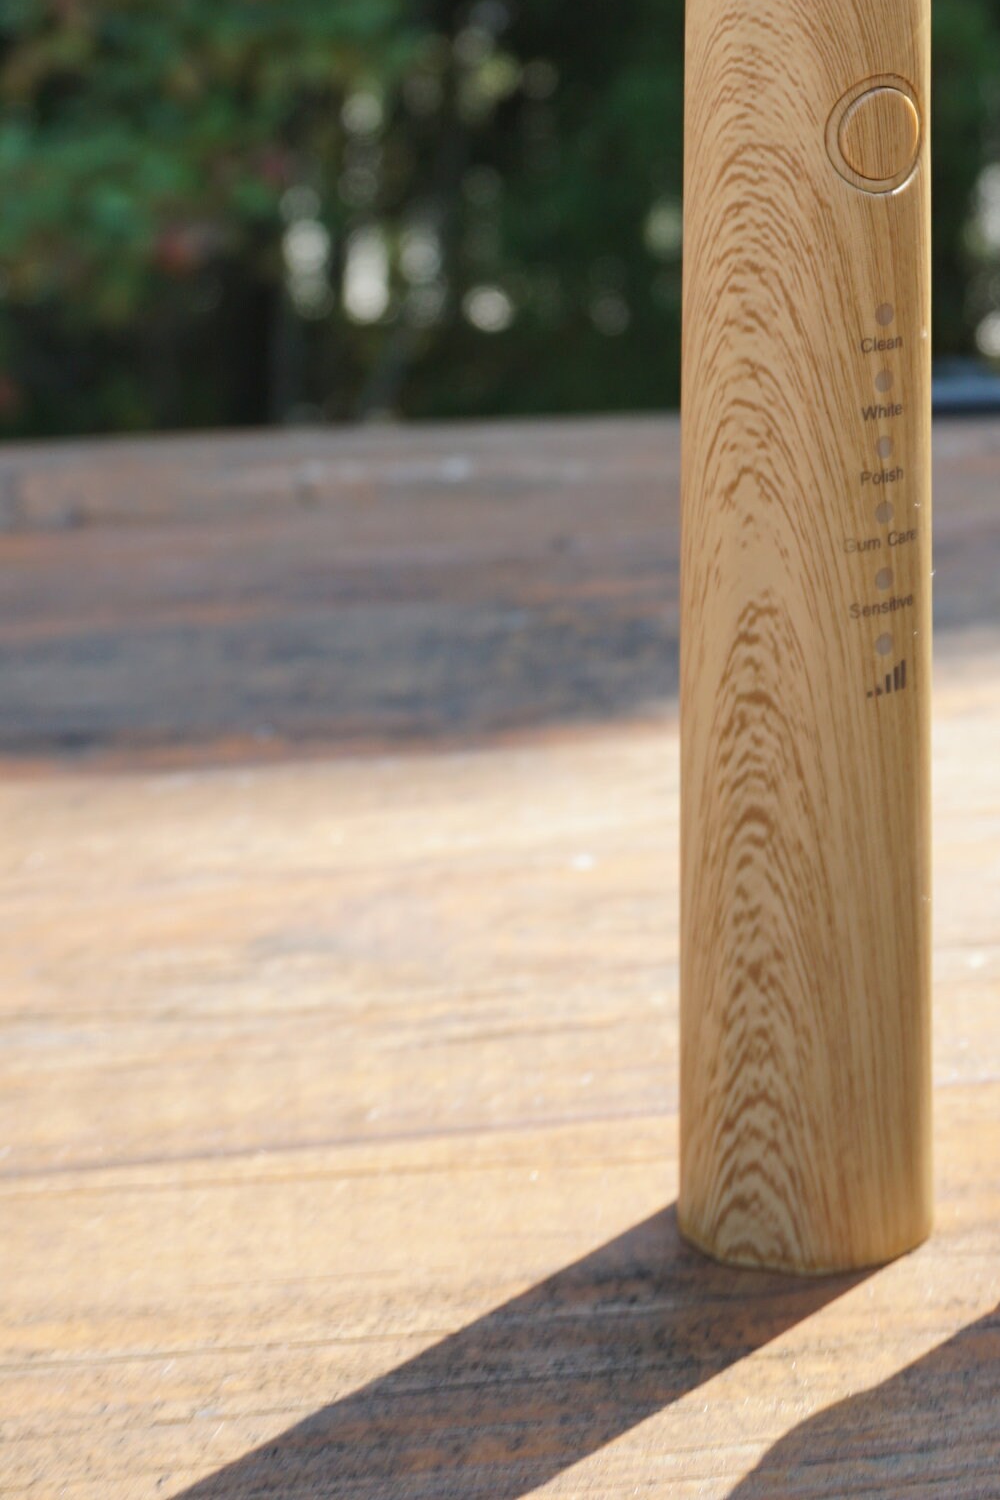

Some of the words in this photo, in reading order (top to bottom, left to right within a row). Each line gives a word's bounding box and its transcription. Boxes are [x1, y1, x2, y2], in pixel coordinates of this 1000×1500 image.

[860, 336, 903, 353] Clean
[861, 403, 903, 421] White
[860, 466, 903, 486] Polish
[887, 528, 917, 547] Care
[850, 594, 914, 619] Sensitive
